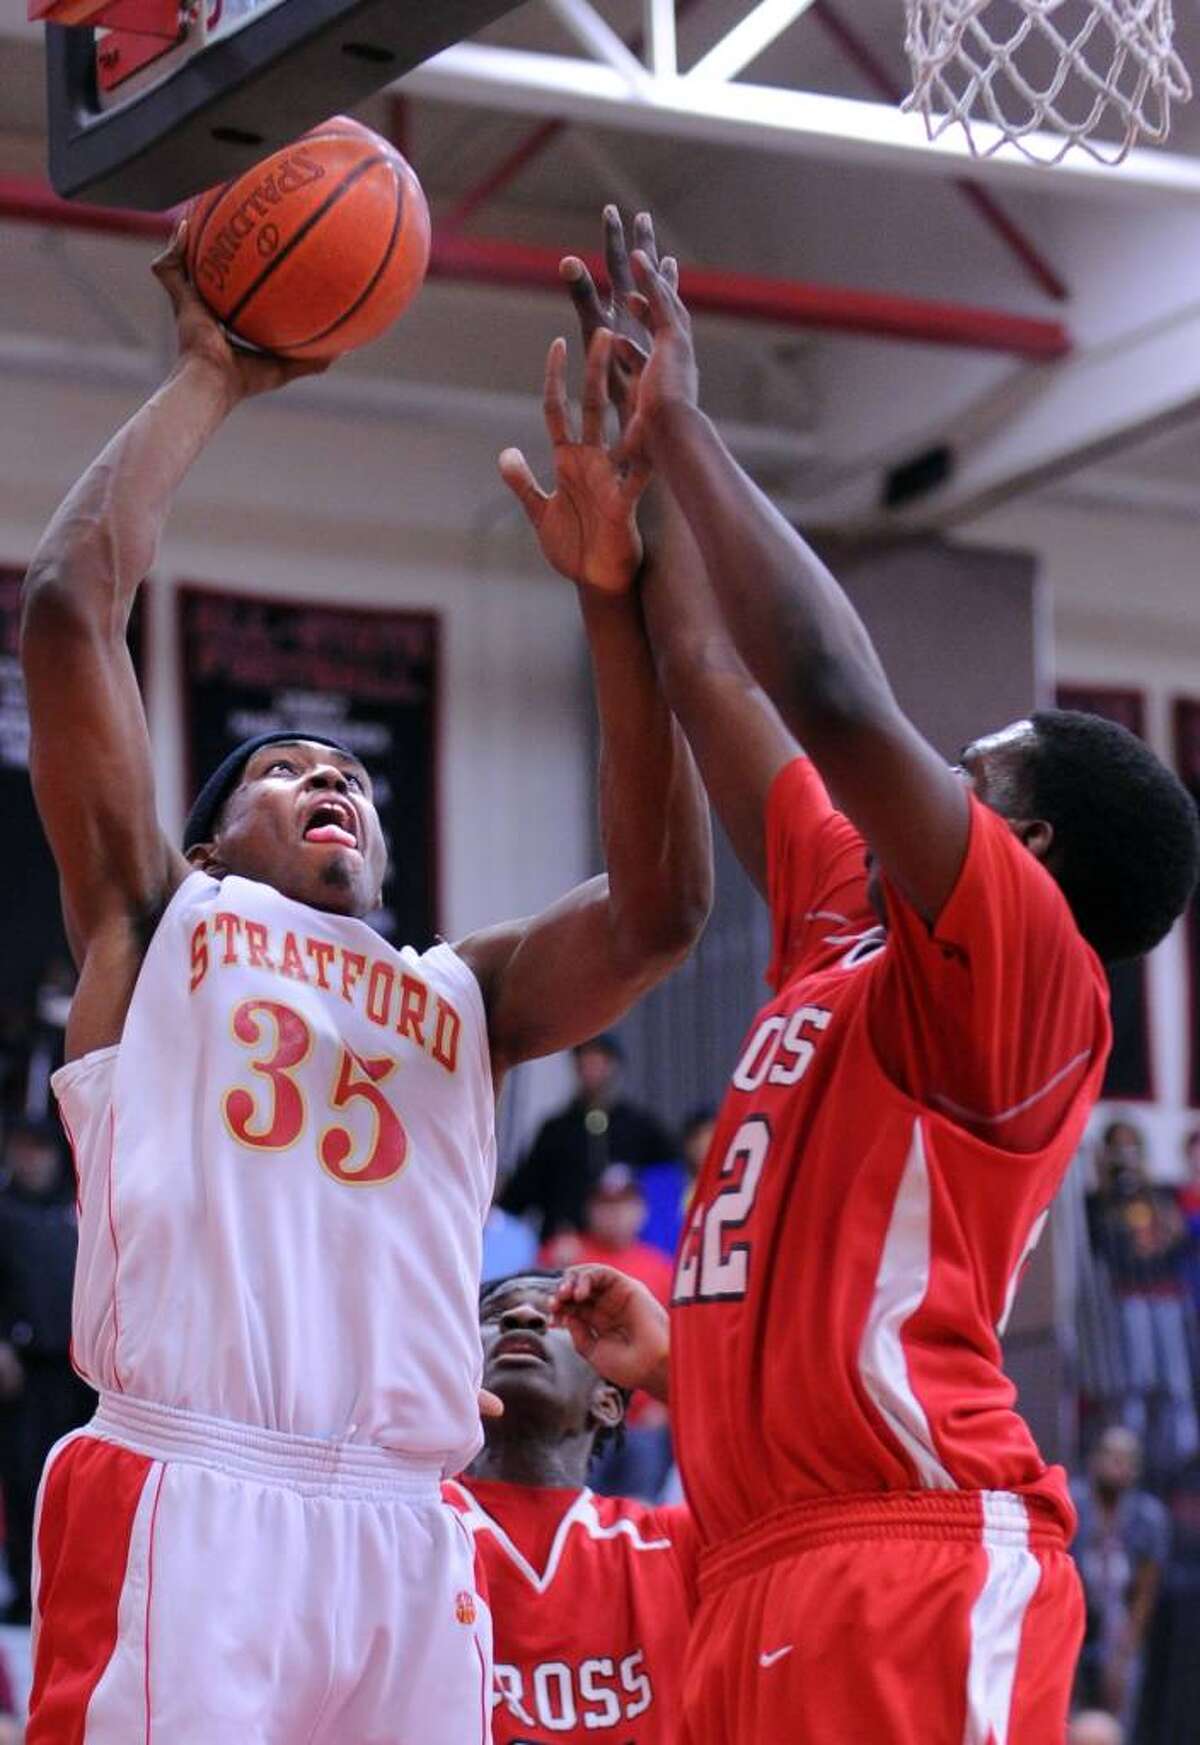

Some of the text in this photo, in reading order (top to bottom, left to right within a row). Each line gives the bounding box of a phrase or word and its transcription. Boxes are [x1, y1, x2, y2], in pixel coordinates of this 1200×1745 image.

[200, 147, 326, 293] SPALDING
[188, 910, 463, 1075] STRATFORD
[222, 998, 410, 1185] 35
